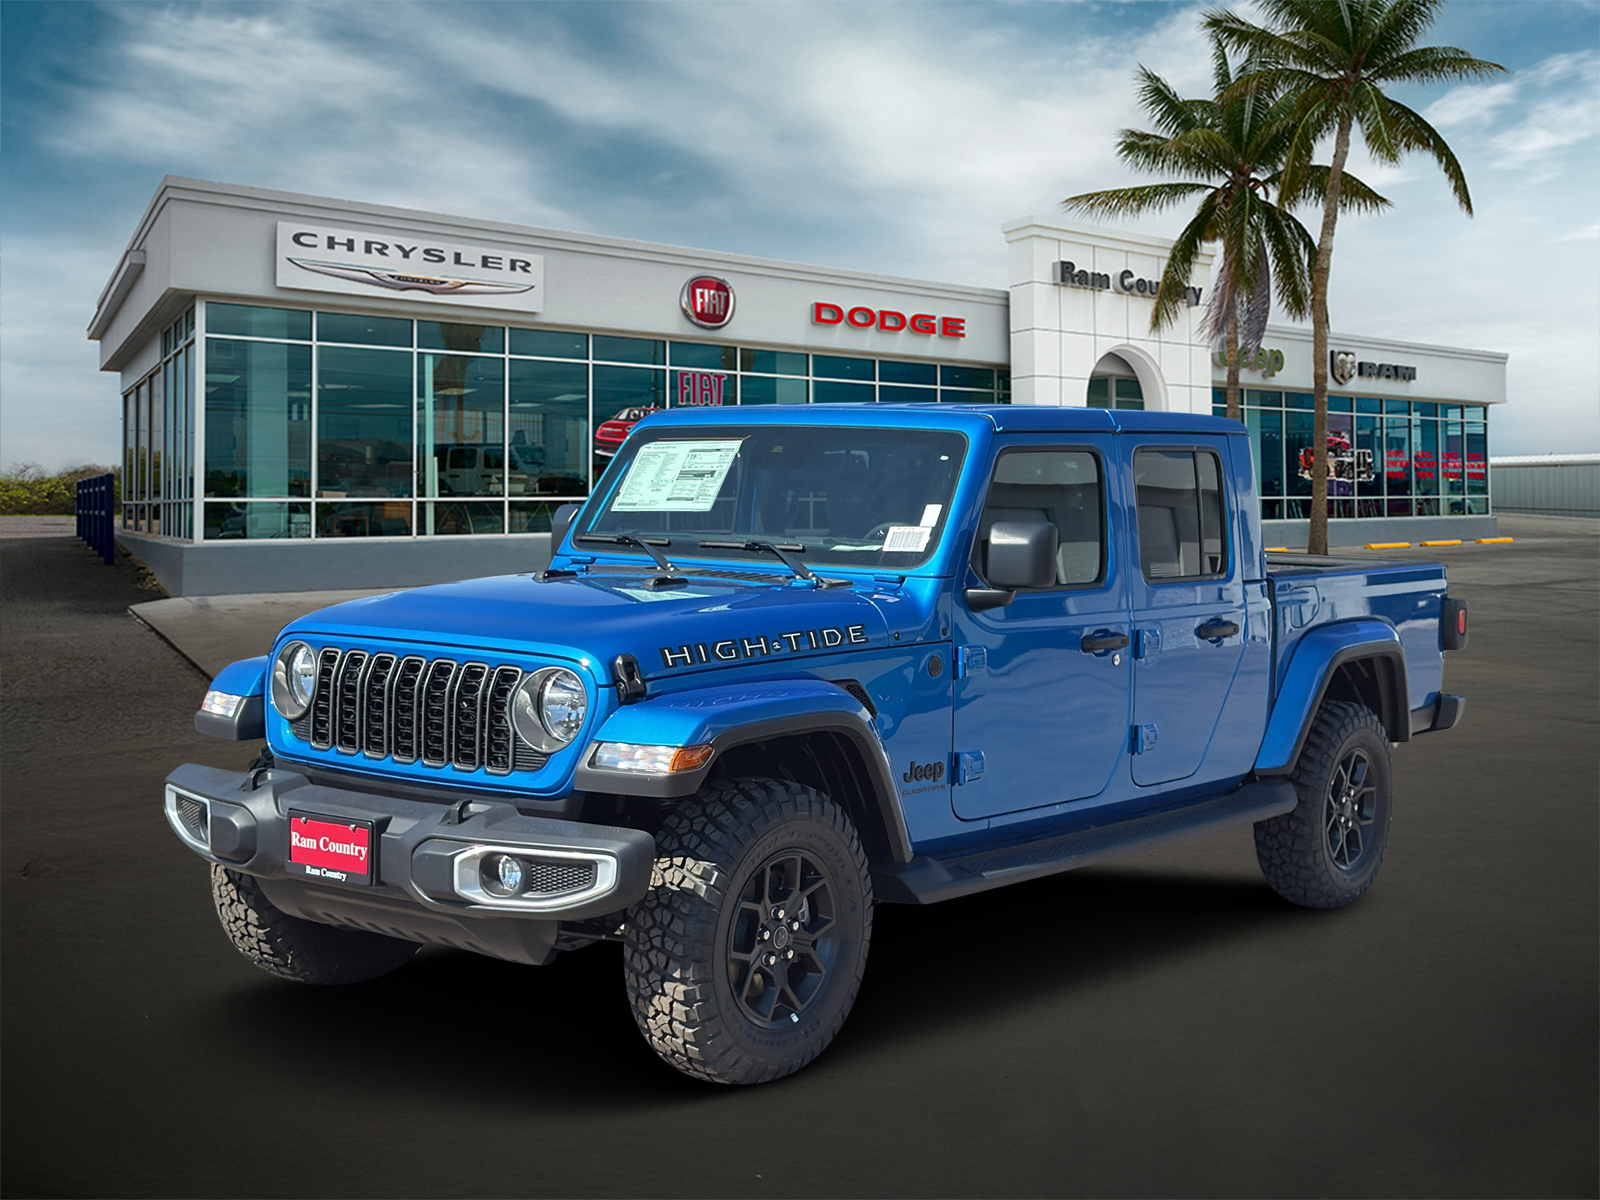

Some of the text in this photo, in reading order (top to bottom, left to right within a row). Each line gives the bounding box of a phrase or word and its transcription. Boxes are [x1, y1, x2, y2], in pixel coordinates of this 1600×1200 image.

[291, 232, 532, 274] CHRYSLER
[1054, 260, 1203, 307] Ram Coury
[695, 288, 728, 316] FIAT
[811, 301, 967, 339] DODGE
[1358, 361, 1417, 381] RAM
[678, 371, 727, 406] FIAT
[659, 623, 870, 669] HIGH TIDE
[903, 761, 944, 783] Jeep
[291, 831, 368, 861] Ram Country
[305, 865, 347, 882] Ram Country
